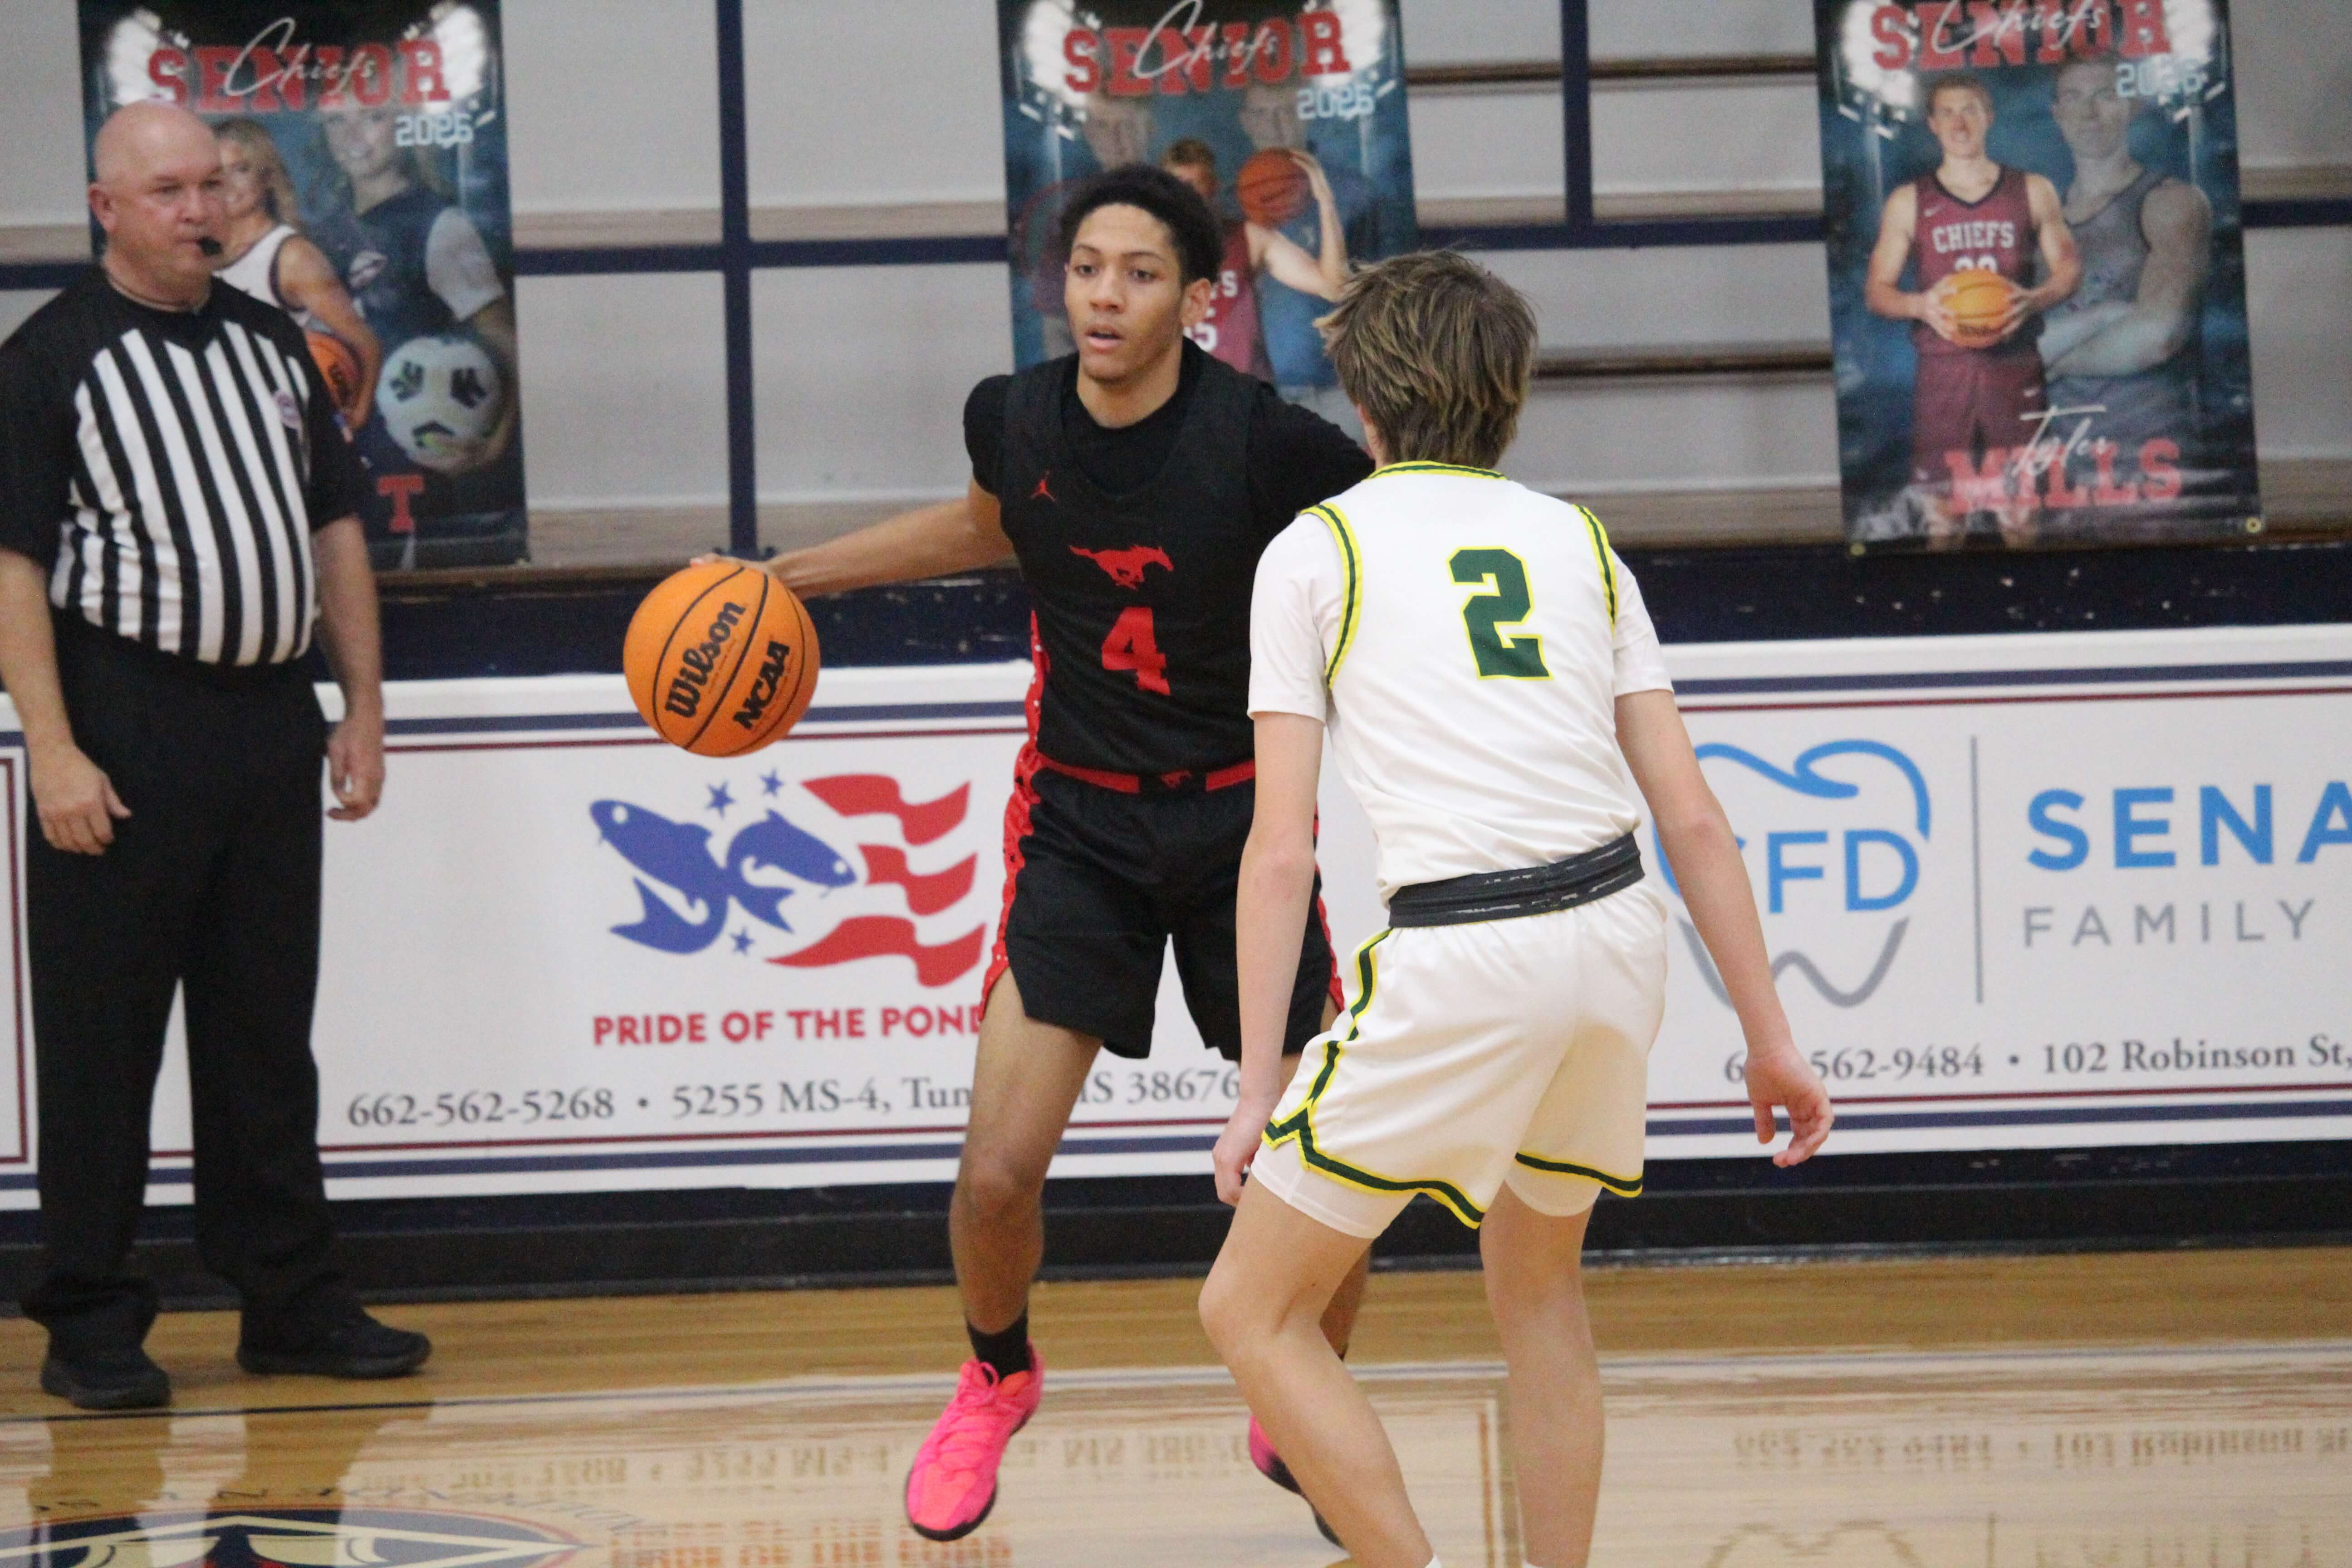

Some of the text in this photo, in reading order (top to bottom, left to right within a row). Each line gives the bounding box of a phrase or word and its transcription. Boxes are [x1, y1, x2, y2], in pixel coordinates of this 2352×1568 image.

[147, 39, 451, 113] SENIOR
[1062, 10, 1352, 97] SENIOR
[1932, 220, 2015, 254] CHIEFS
[1943, 437, 2182, 516] MILLS
[1101, 606, 1171, 696] 4
[1446, 546, 1553, 681] 2
[665, 602, 746, 718] Wilson
[733, 641, 790, 729] NCAA
[2027, 780, 2352, 872] SENA
[1734, 828, 1920, 914] FD
[2023, 898, 2315, 947] FAMILY
[593, 1014, 708, 1046] PRIDE
[721, 1011, 774, 1044] OF
[787, 1008, 865, 1040] THE
[2043, 1042, 2107, 1074] 102
[2122, 1038, 2297, 1072] Robinson
[348, 1087, 614, 1127] 662-562-5268
[672, 1083, 764, 1118] 5255
[778, 1077, 892, 1114] MS-4,
[1127, 1066, 1241, 1103] 38676
